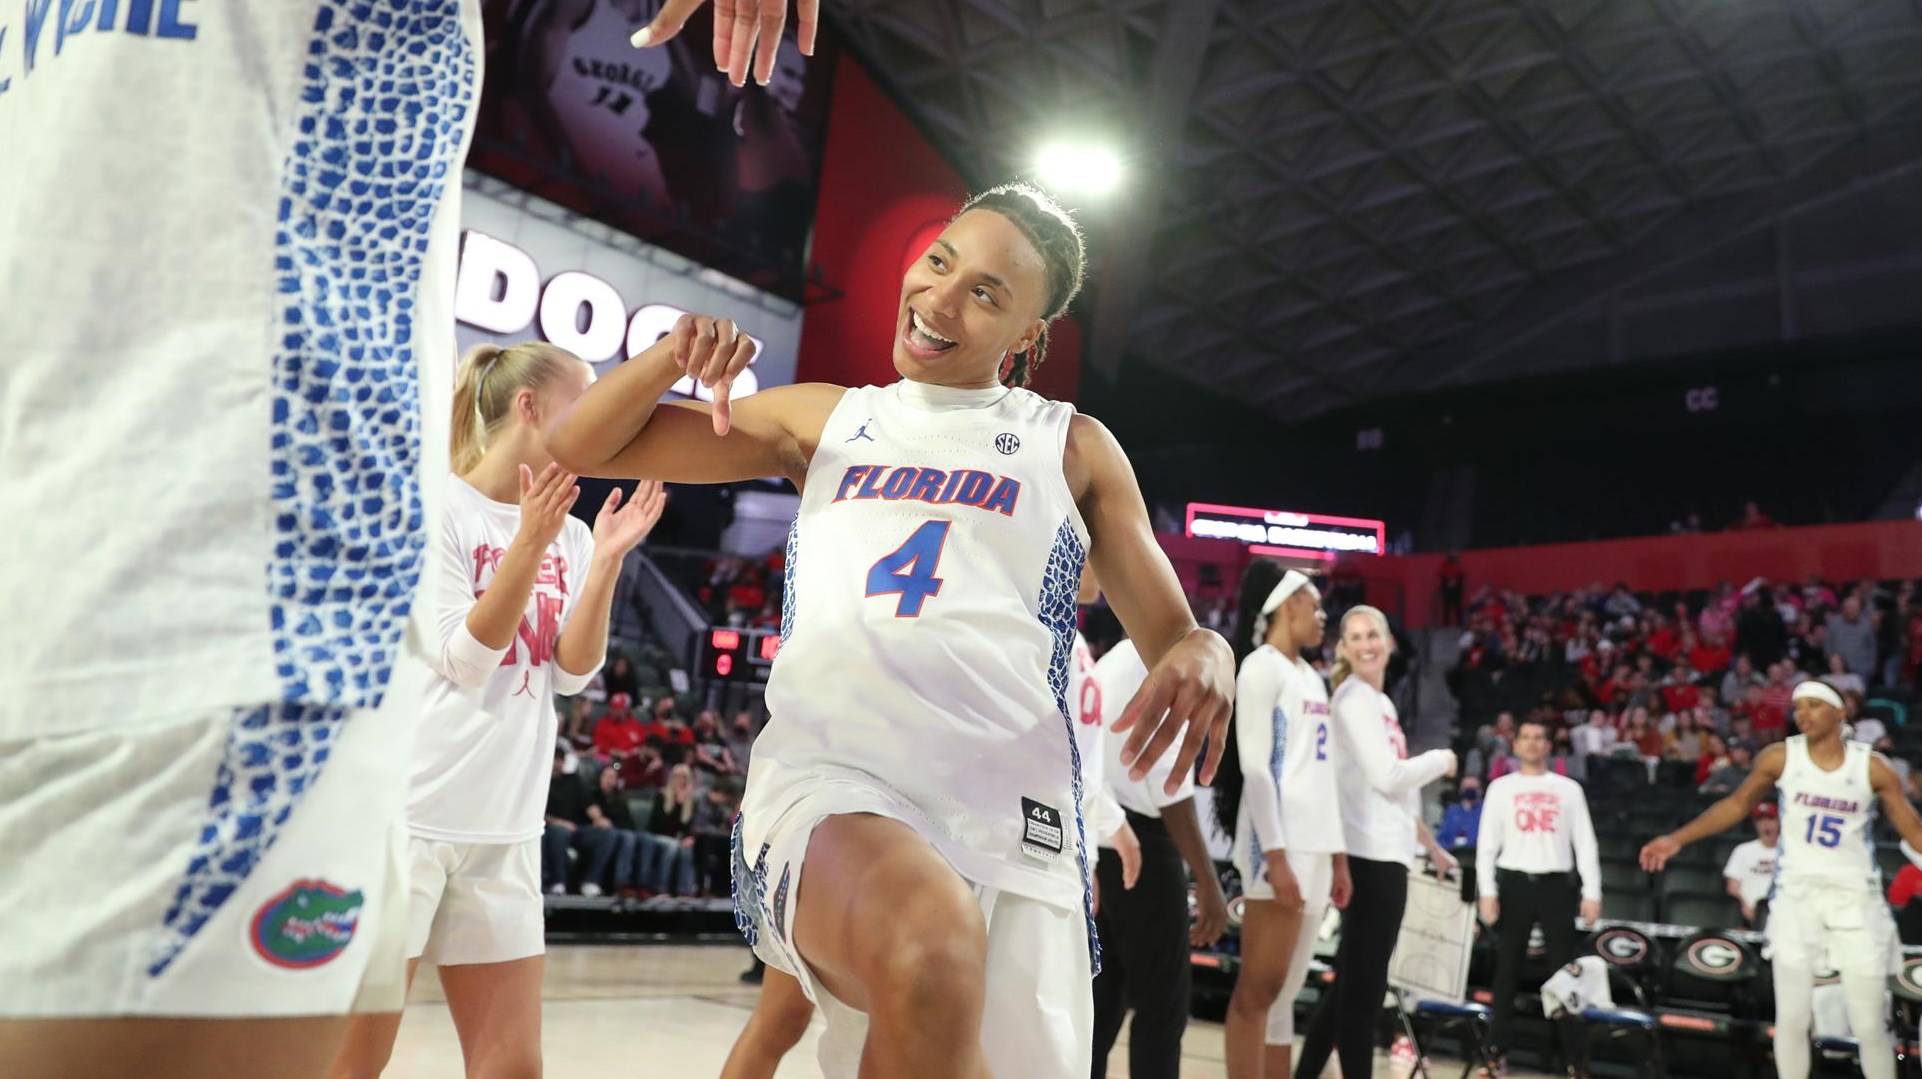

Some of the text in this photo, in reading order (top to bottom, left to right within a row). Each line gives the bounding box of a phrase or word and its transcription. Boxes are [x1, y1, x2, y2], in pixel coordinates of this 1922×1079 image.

[996, 434, 1020, 454] SEC
[831, 464, 1021, 517] FLORIDA
[865, 519, 952, 618] 4
[1315, 723, 1327, 760] 2
[1031, 806, 1051, 823] 44
[1515, 808, 1558, 833] ONE
[1806, 814, 1844, 849] 15
